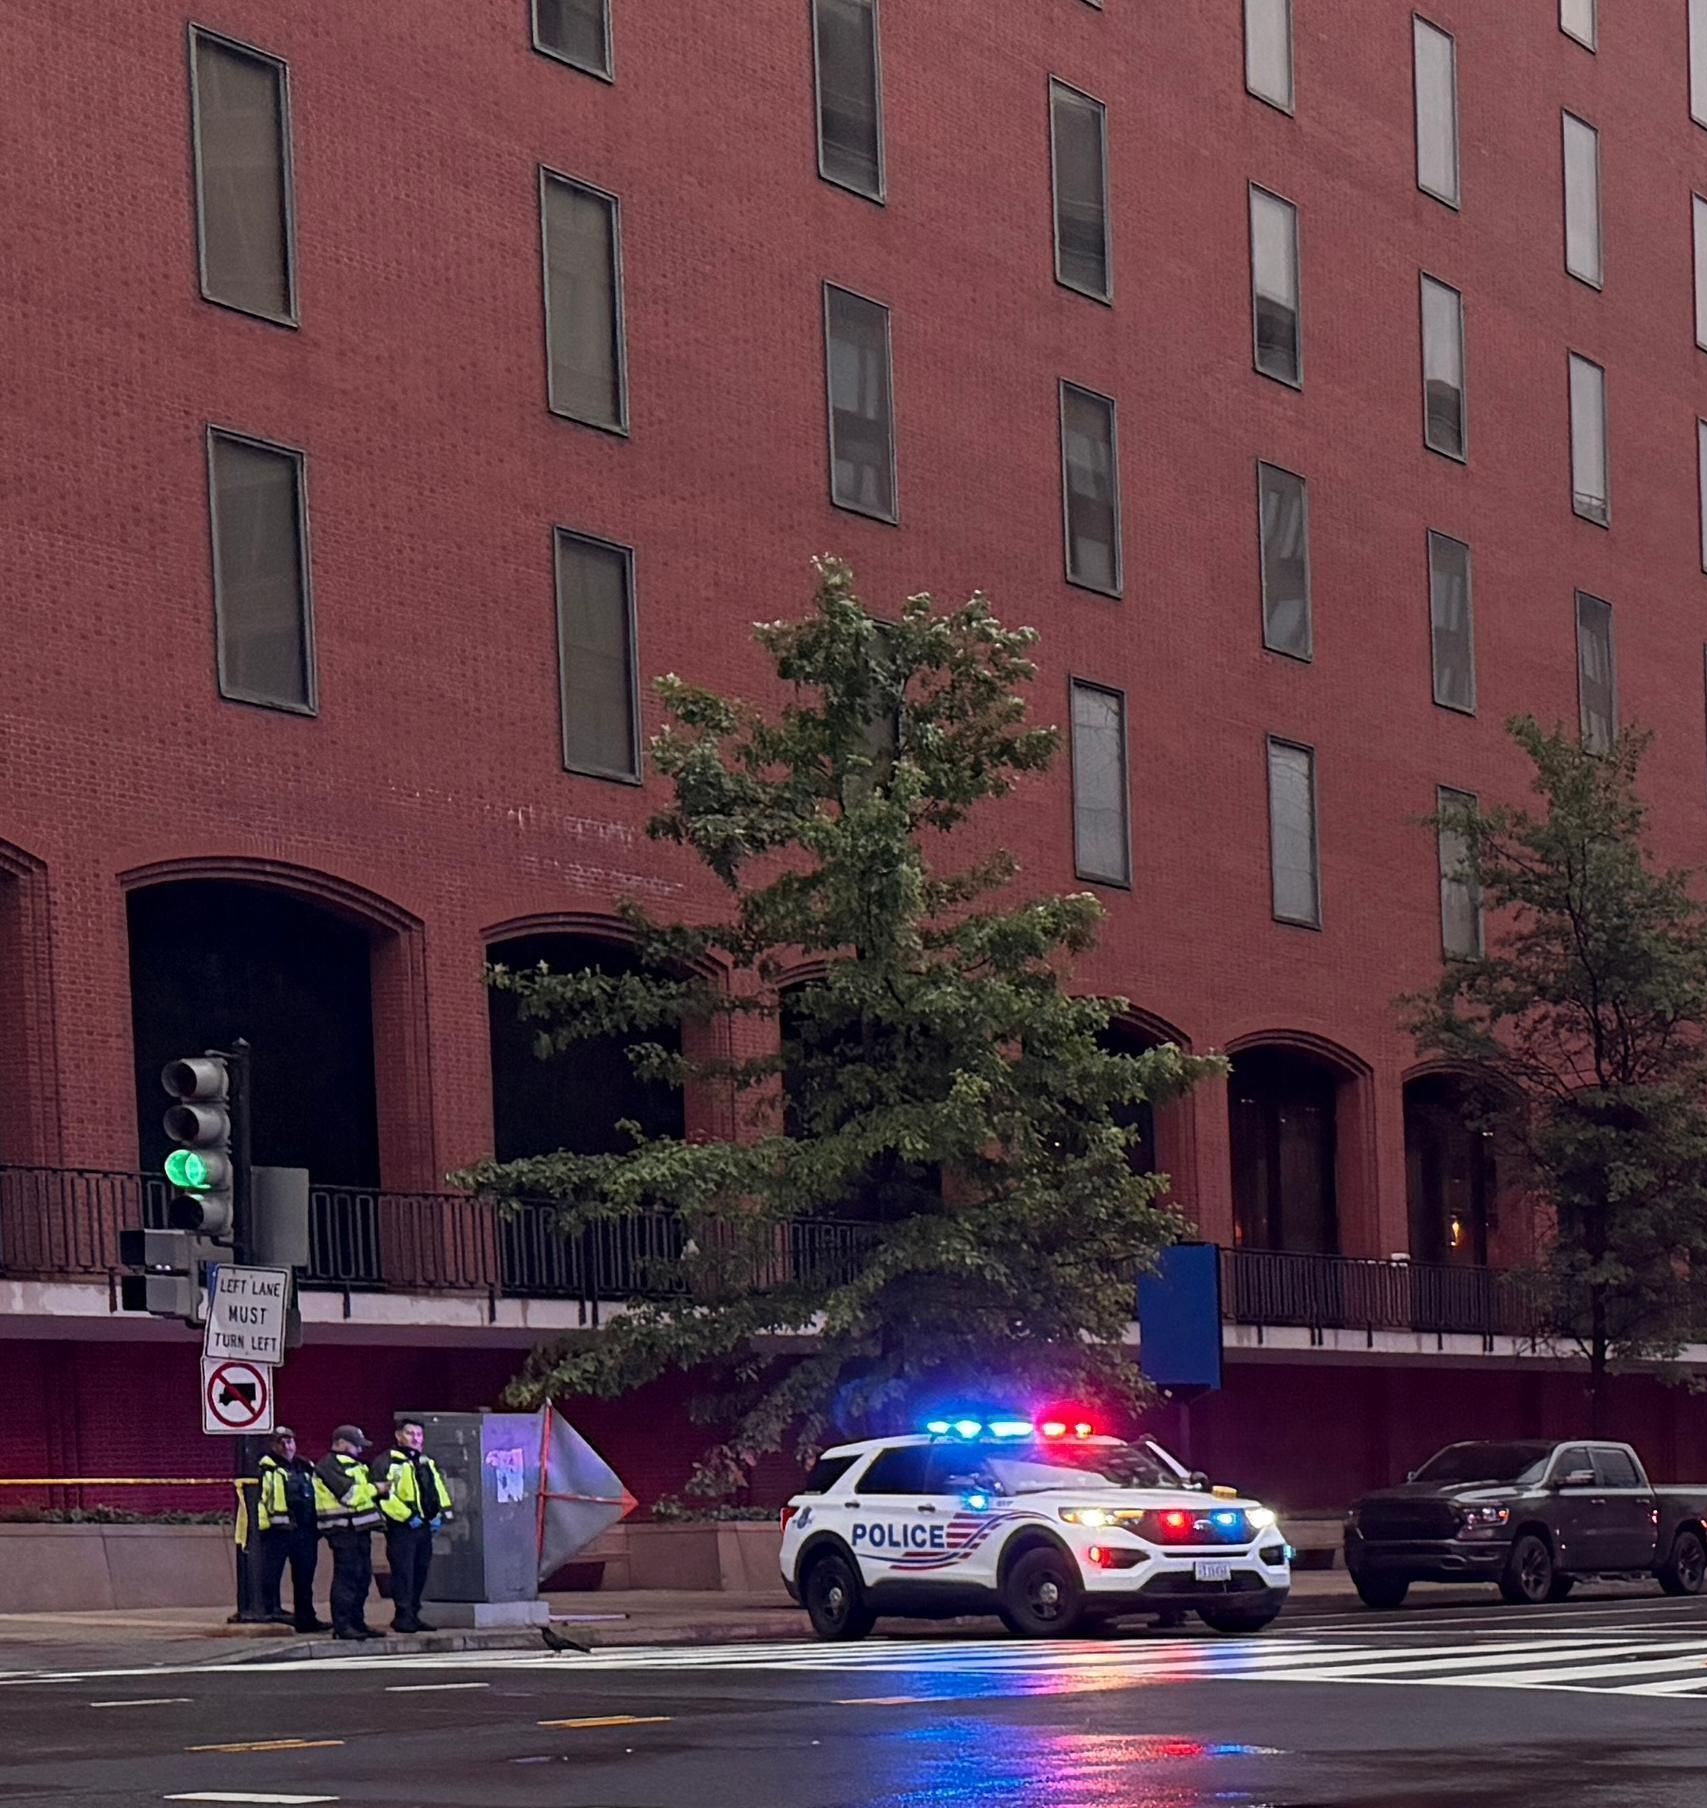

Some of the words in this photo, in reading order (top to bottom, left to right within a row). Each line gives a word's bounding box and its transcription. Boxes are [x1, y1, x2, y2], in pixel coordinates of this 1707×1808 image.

[220, 1278, 247, 1295] LEFT
[252, 1281, 281, 1297] LANE
[228, 1305, 267, 1325] MUST
[214, 1332, 245, 1349] TURN
[251, 1336, 277, 1352] LEFT
[851, 1523, 945, 1549] POLICE
